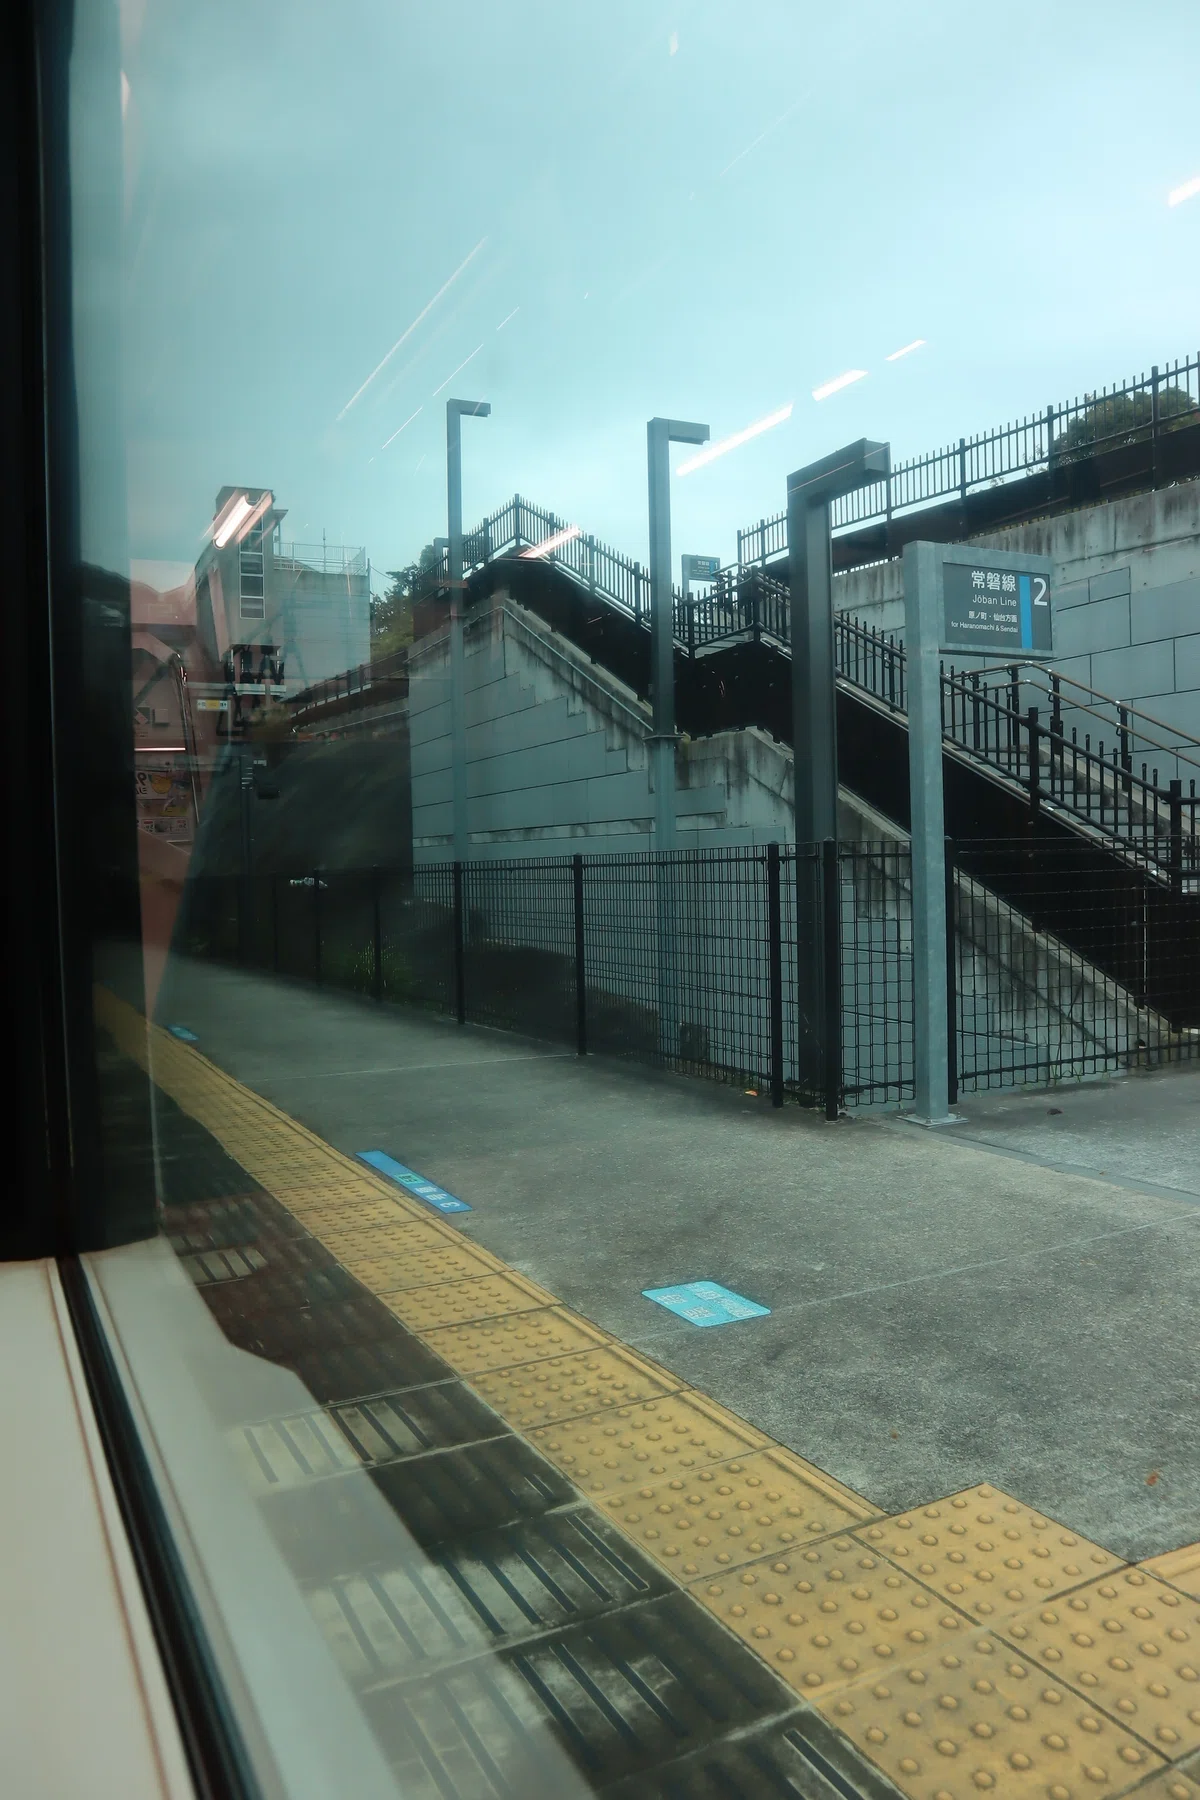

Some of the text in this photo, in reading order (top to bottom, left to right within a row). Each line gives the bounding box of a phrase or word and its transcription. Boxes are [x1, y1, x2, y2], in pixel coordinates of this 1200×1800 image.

[971, 571, 1017, 592] 常磐線
[1033, 577, 1048, 606] 2
[972, 594, 1017, 607] Jōban Line
[959, 622, 995, 631] Haranomachi
[1000, 625, 1018, 633] Sendai
